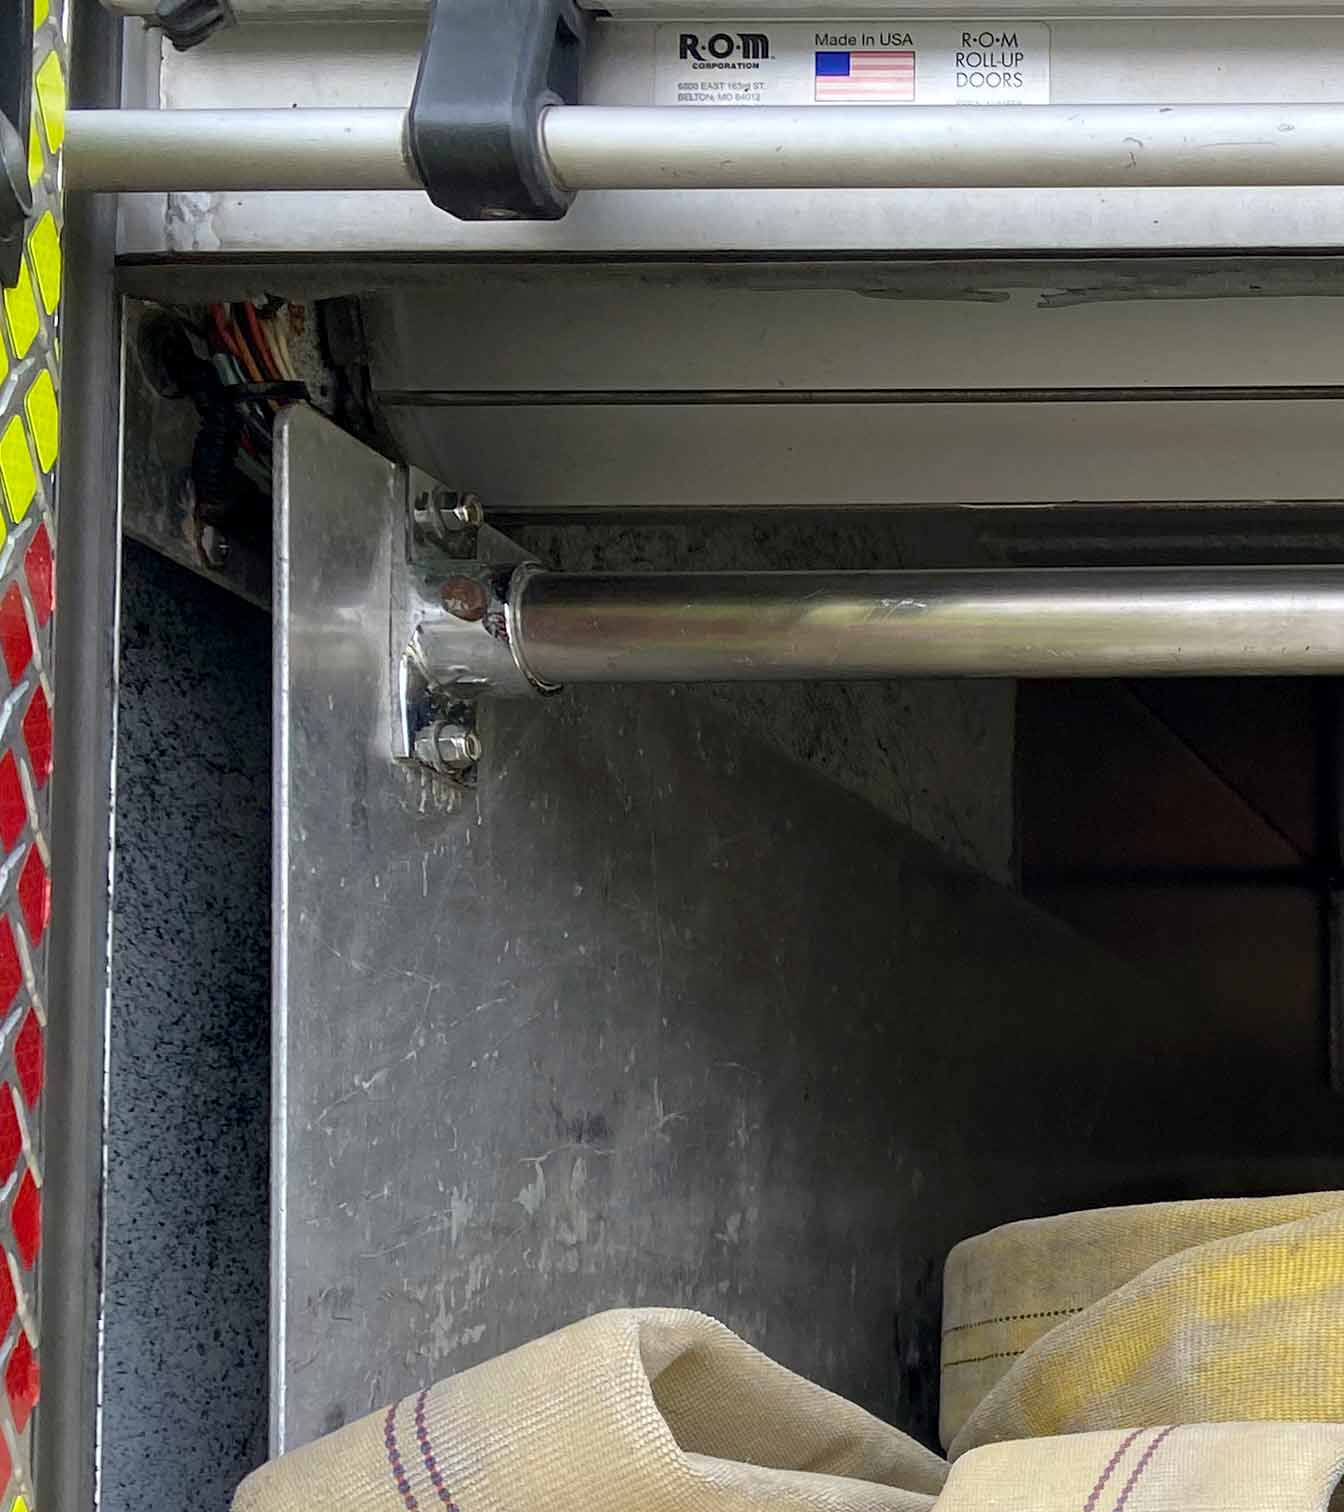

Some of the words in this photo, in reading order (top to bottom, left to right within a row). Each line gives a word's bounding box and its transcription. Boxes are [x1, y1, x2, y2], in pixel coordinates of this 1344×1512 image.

[815, 33, 857, 46] Made
[862, 33, 875, 46] In
[879, 32, 913, 46] USA
[691, 62, 760, 70] CORPORATION
[955, 51, 1024, 68] ROLL-UP
[955, 71, 1024, 88] DOORS
